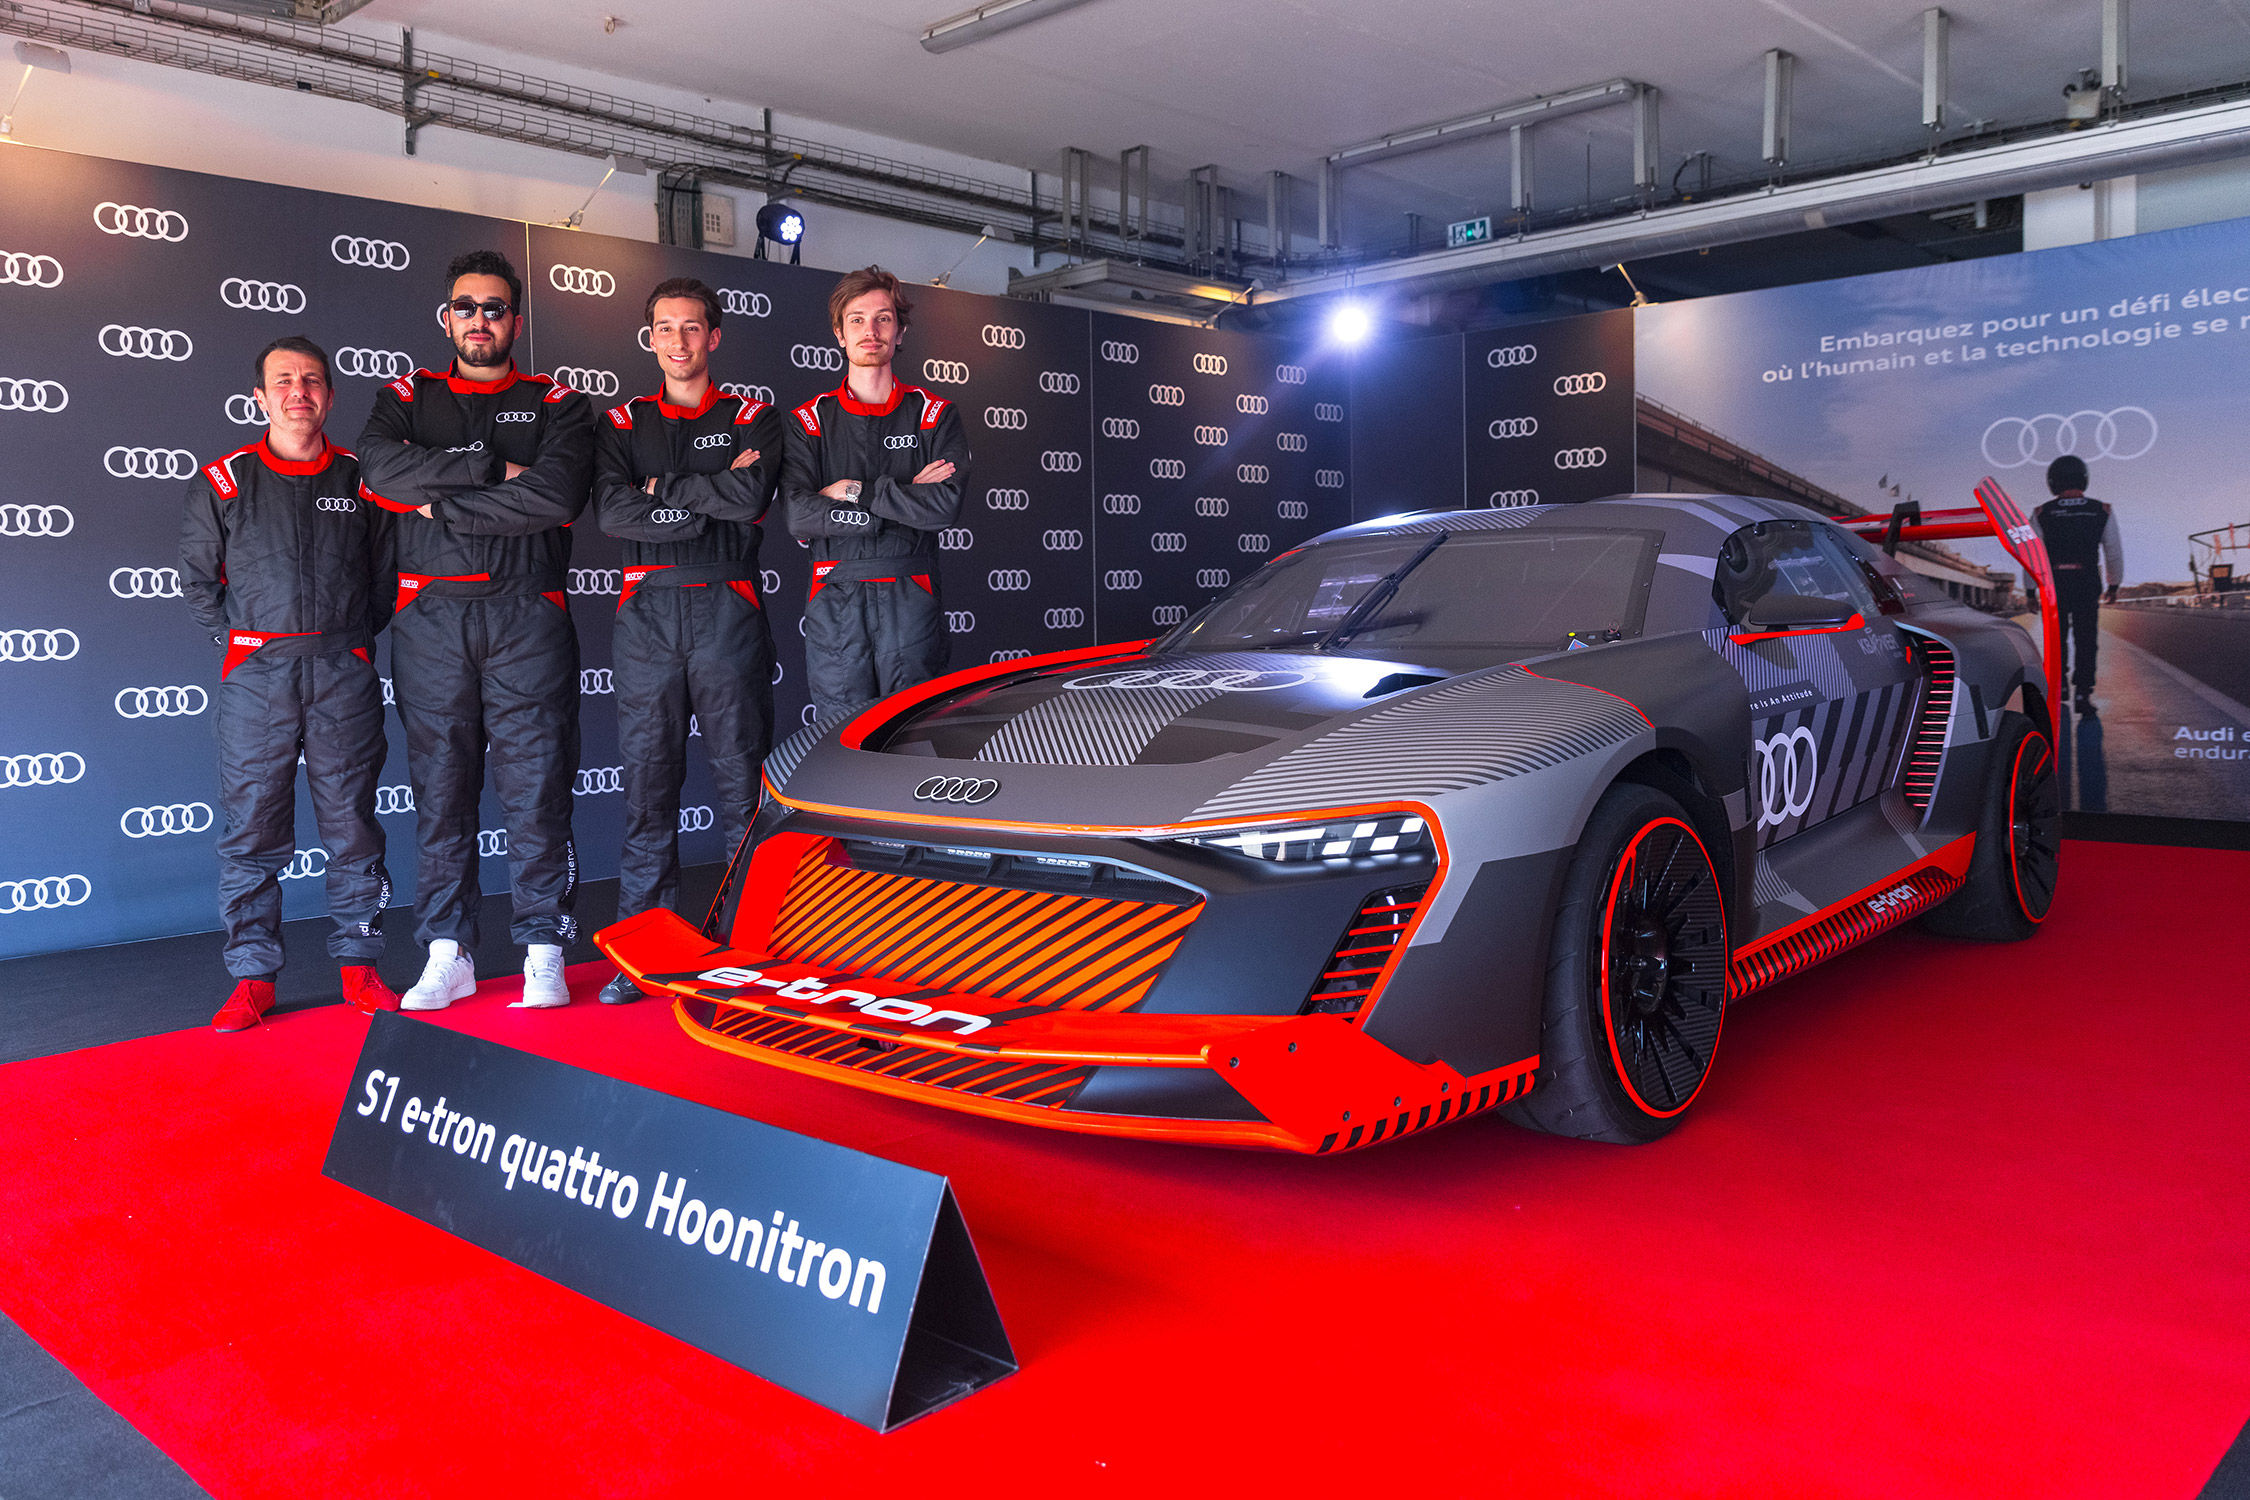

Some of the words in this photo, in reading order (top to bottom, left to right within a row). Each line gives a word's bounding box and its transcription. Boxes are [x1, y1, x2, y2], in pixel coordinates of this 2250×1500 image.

[1820, 322, 1974, 352] Embarquez
[1982, 312, 2052, 338] pour
[2061, 307, 2098, 325] un
[2108, 292, 2171, 318] défi
[1762, 365, 1793, 383] où
[1924, 348, 1954, 366] et
[1962, 344, 1987, 362] la
[1995, 321, 2182, 358] technologie
[2191, 318, 2229, 335] se
[208, 465, 232, 494] sparco
[232, 635, 263, 647] sparco
[1781, 688, 1813, 703] Attitude
[2173, 726, 2235, 742] Audi
[2174, 745, 2250, 760] endur
[1867, 884, 1918, 913] e-tron
[697, 966, 992, 1036] e-tron
[357, 1068, 400, 1123] S1
[400, 1096, 496, 1164] e-tron
[500, 1133, 640, 1219] quattro
[644, 1170, 887, 1315] Hoonitron
